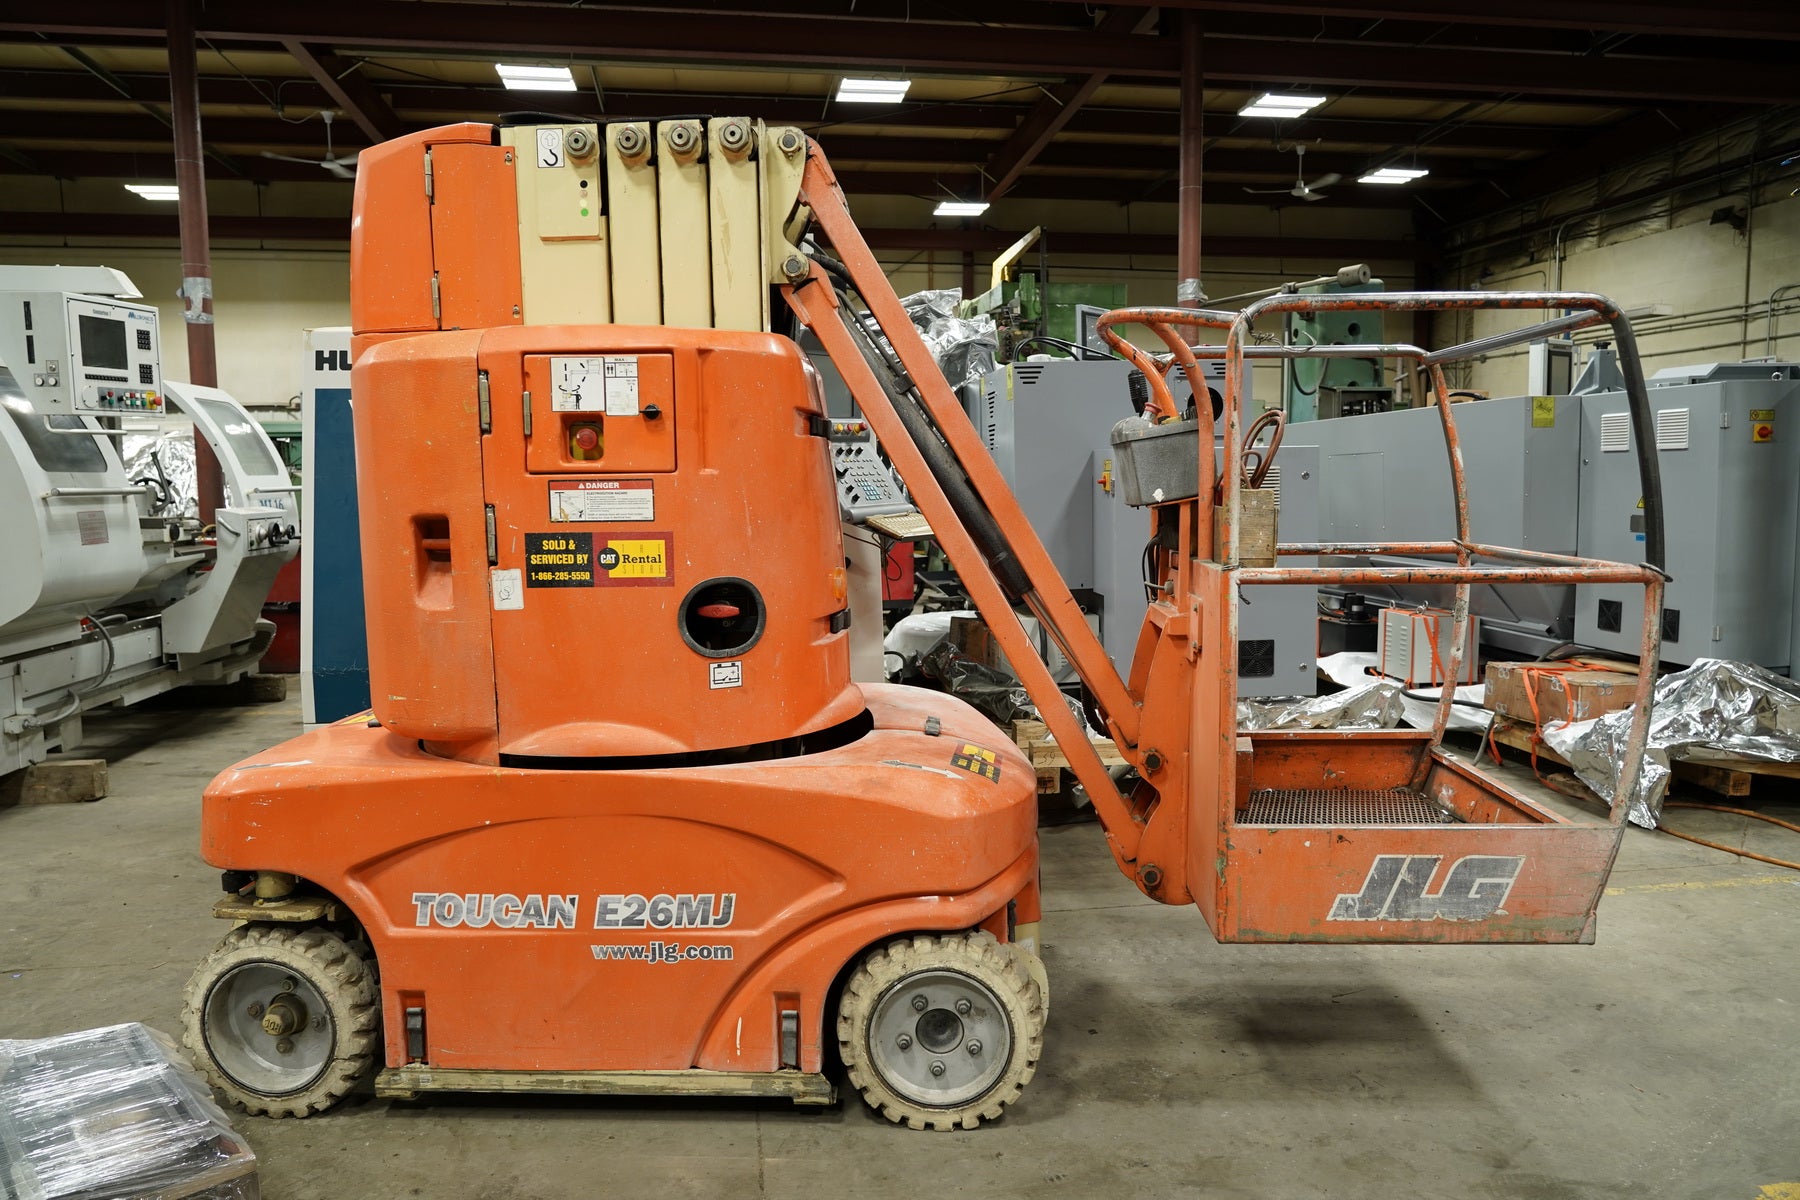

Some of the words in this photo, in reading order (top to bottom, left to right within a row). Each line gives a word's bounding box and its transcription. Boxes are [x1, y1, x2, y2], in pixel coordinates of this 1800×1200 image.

[542, 539, 566, 550] SOLD
[568, 539, 576, 550] &
[530, 553, 575, 565] SERVICED
[576, 553, 589, 565] BY
[600, 553, 617, 564] CAT
[622, 554, 662, 564] Rental
[531, 571, 590, 581] 1-866-285-5550
[1326, 854, 1526, 921] JLG
[411, 892, 579, 929] TOUCAN
[594, 893, 736, 929] E26MJ
[590, 941, 734, 965] www.jlg.com
